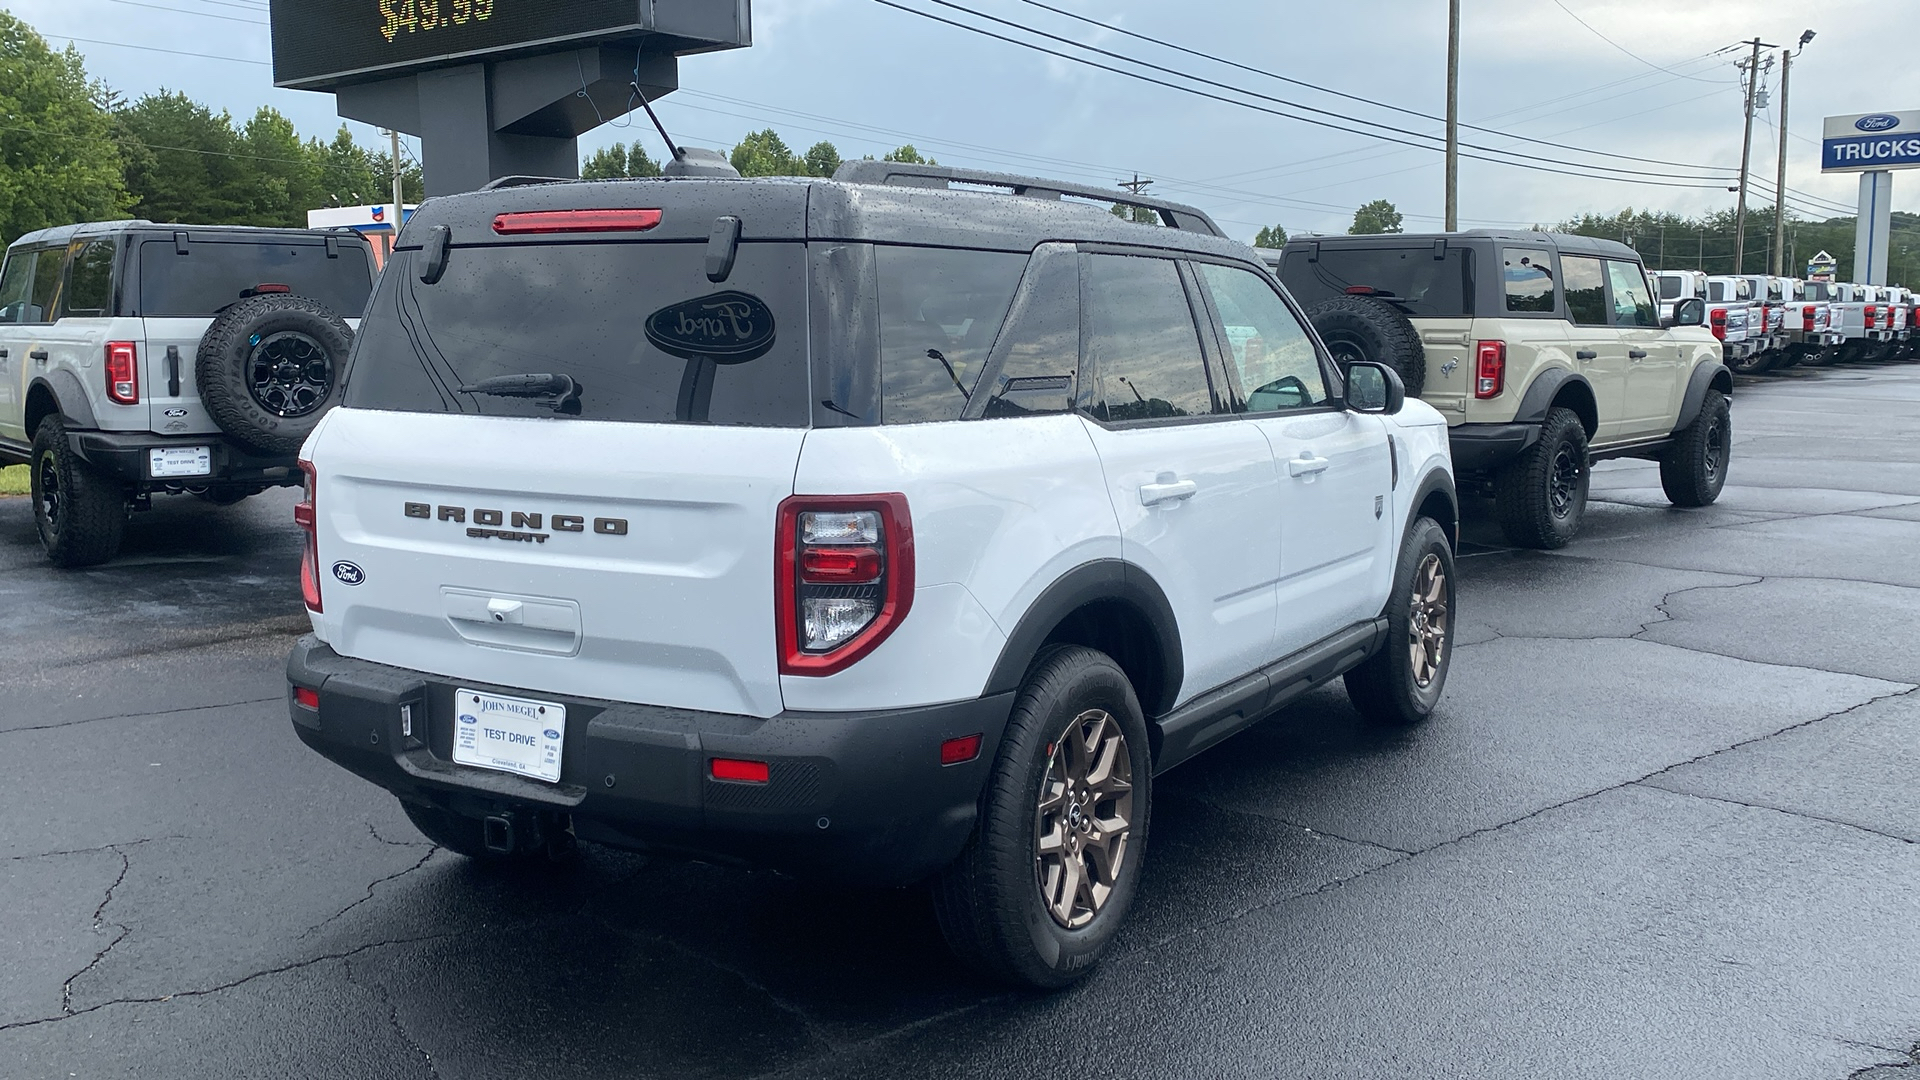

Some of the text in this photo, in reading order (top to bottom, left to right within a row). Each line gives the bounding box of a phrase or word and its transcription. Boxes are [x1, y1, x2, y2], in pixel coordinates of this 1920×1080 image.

[1863, 117, 1890, 129] Ford
[1833, 140, 1920, 160] TRUCKS
[167, 409, 185, 418] Ford
[404, 501, 629, 536] BRONCO
[465, 527, 550, 544] SPORT
[336, 561, 359, 583] Ford
[481, 700, 539, 720] JOHN MEGEL
[484, 728, 506, 741] TEST
[509, 732, 536, 746] DRIVE
